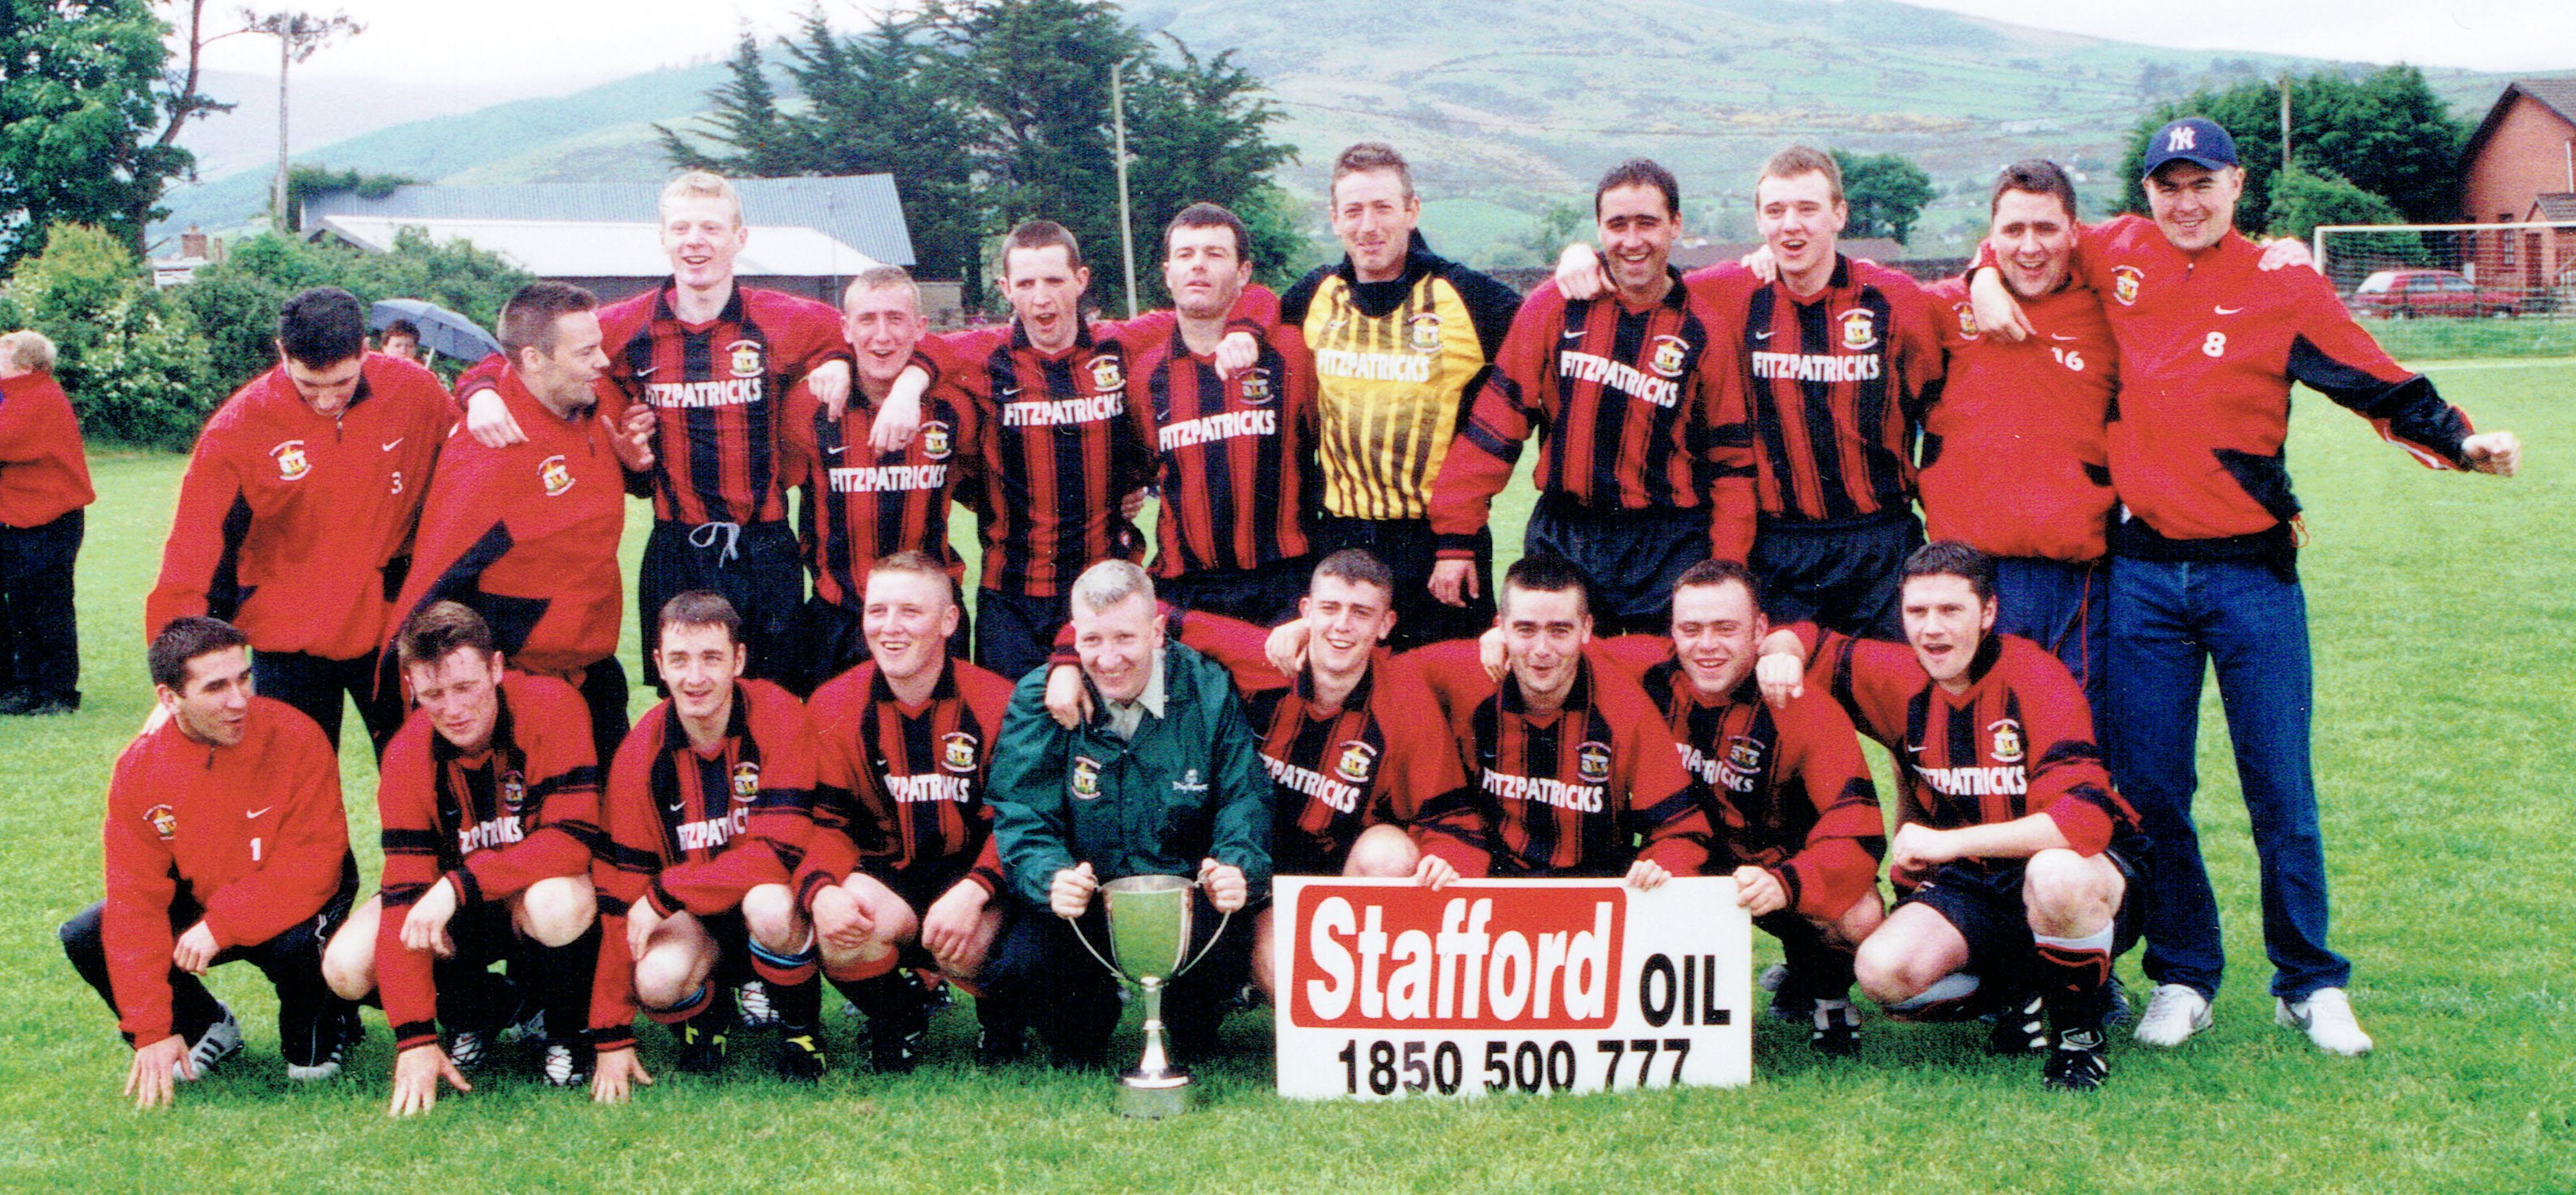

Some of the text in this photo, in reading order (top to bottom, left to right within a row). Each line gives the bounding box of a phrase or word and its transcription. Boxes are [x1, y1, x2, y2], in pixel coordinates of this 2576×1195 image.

[2050, 346, 2085, 372] 16
[2202, 331, 2227, 358] 8
[1317, 348, 1431, 383] FITZPATRICKS
[1561, 351, 1679, 408] FITZPATRICKS
[1752, 351, 1880, 382] FITZPATRICKS
[645, 377, 762, 408] FITZPATRICKS
[1003, 391, 1124, 426] FITZPATRICKS
[1158, 409, 1276, 451] FITZPATRICKS
[390, 471, 403, 495] 3
[829, 464, 948, 493] FITZPATRICKS
[1482, 766, 1604, 814] FITZPATRICKS
[249, 837, 262, 862] 1
[1306, 896, 1731, 1028] Stafford OIL
[1338, 1038, 1692, 1096] 1850 500 777
